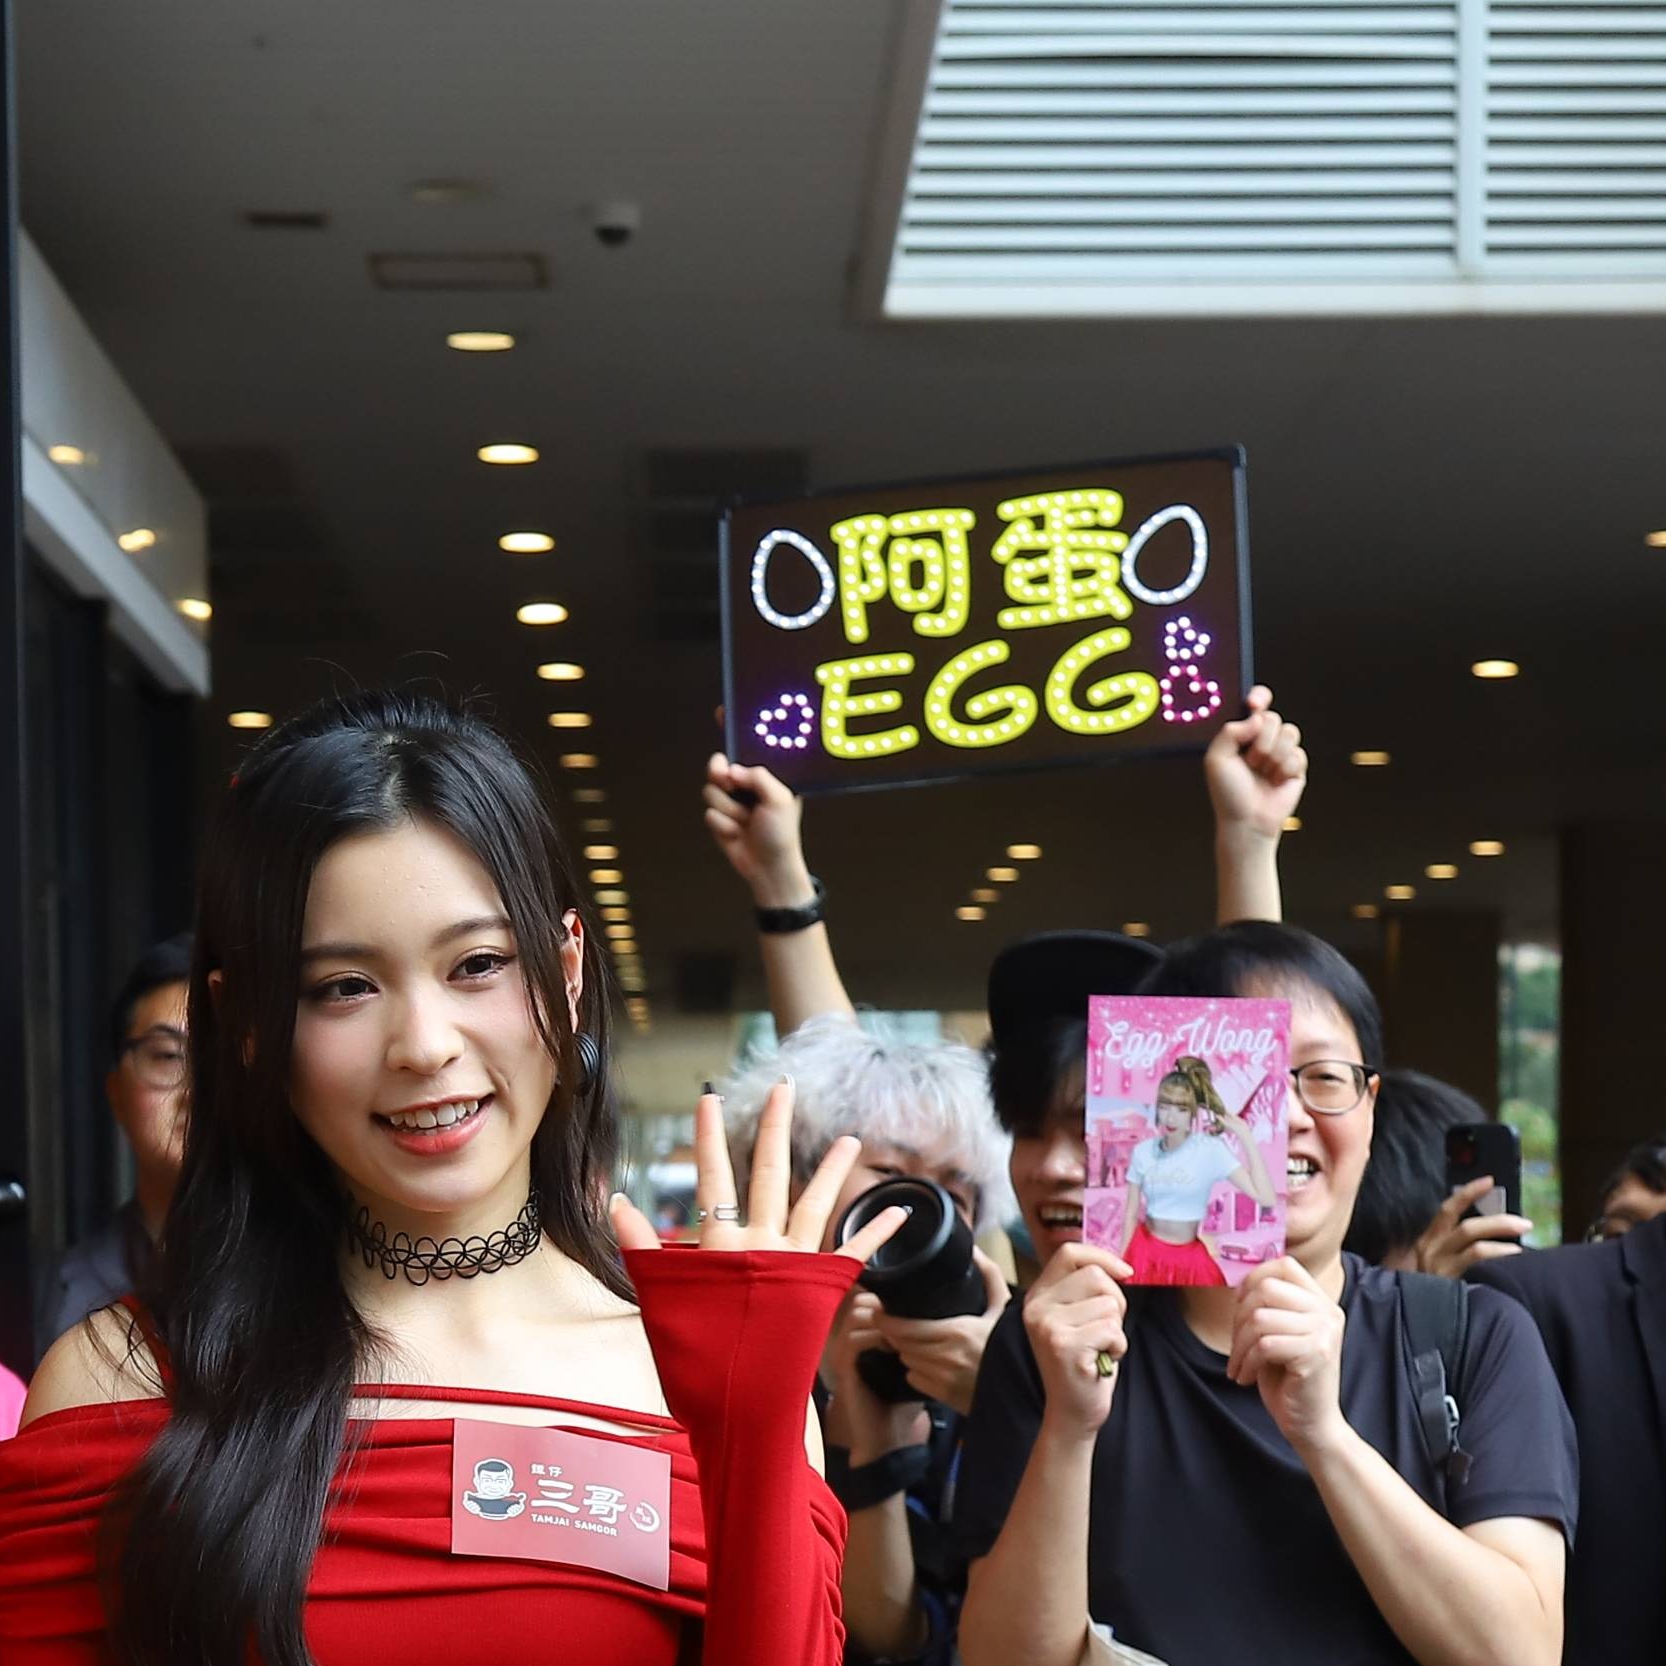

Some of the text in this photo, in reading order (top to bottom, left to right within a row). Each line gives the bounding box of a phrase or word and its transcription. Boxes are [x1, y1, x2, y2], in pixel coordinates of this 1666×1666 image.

[829, 487, 1134, 643] 阿蛋
[814, 626, 1161, 760] EGG
[1103, 1014, 1279, 1068] Egg Wong
[530, 1479, 628, 1525] 三哥
[531, 1513, 570, 1527] TAMJAI
